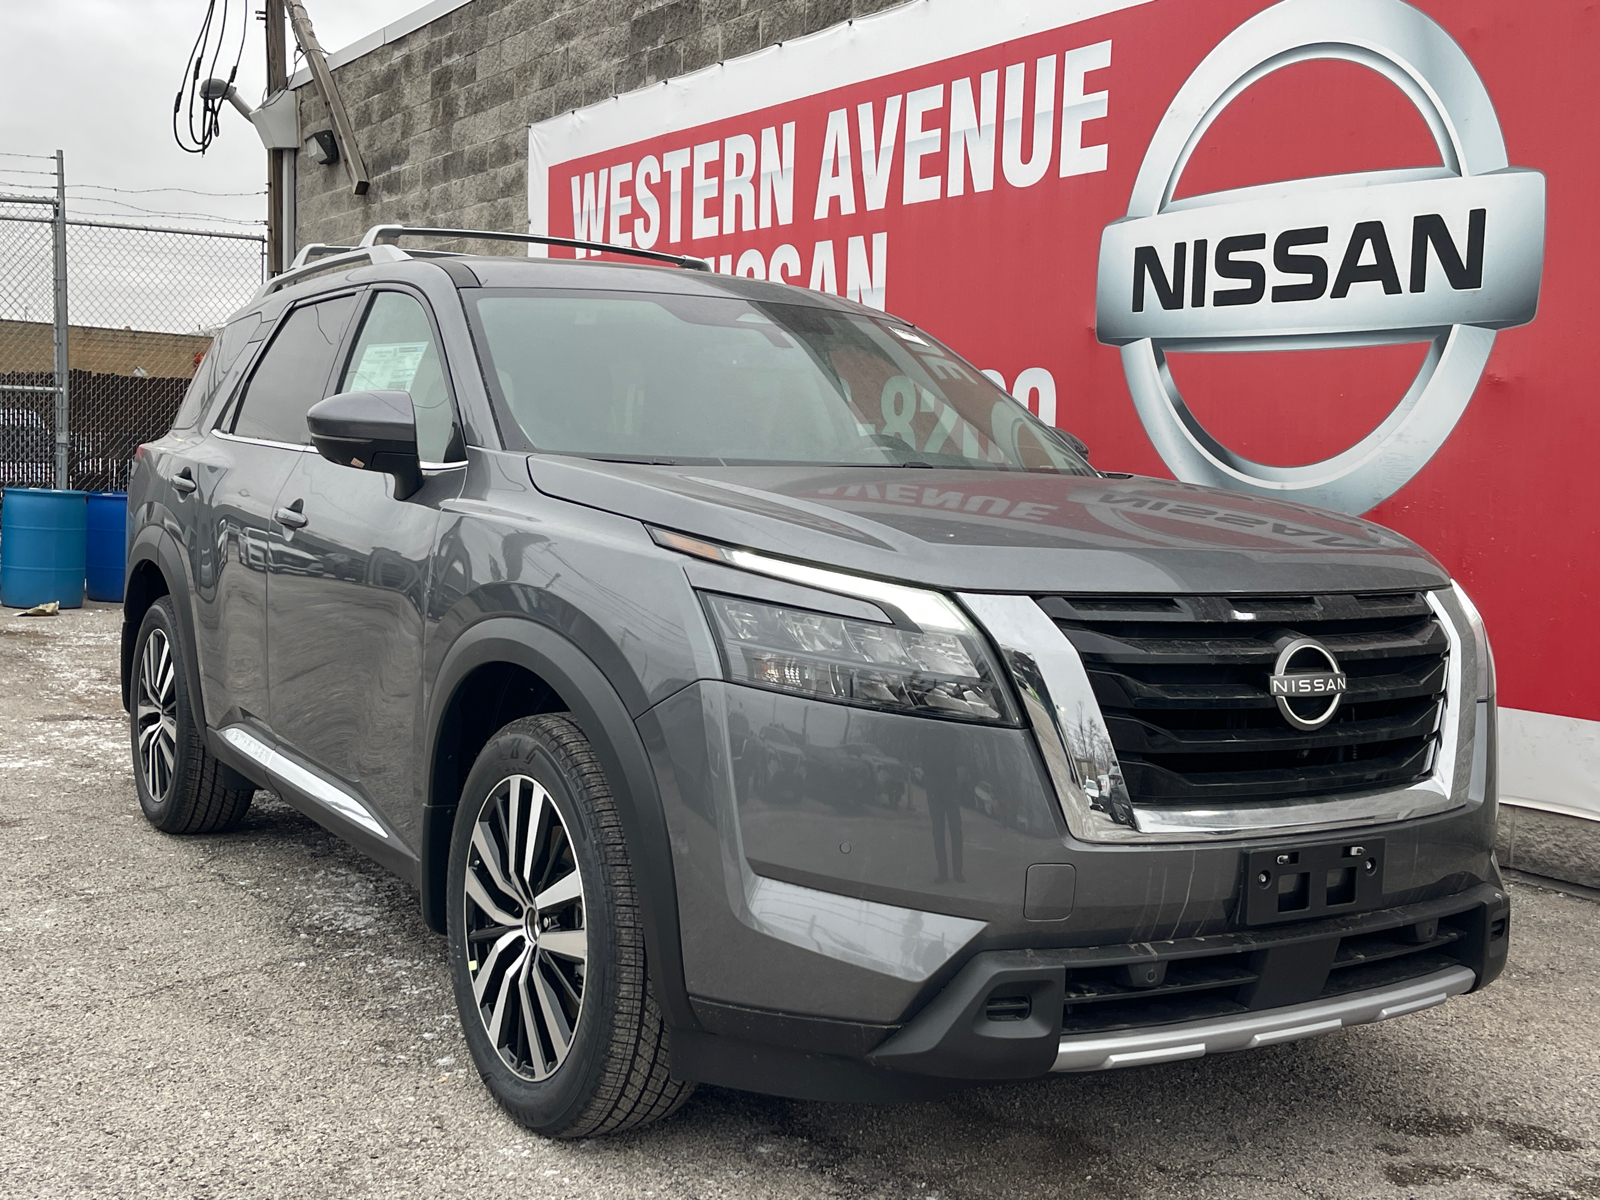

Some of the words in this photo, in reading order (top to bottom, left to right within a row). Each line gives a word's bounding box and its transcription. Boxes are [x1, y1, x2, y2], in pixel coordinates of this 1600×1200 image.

[571, 121, 796, 260] WESTERN
[814, 39, 1112, 220] AVENUE
[1132, 208, 1486, 313] NISSAN
[1273, 677, 1346, 693] NISSAN
